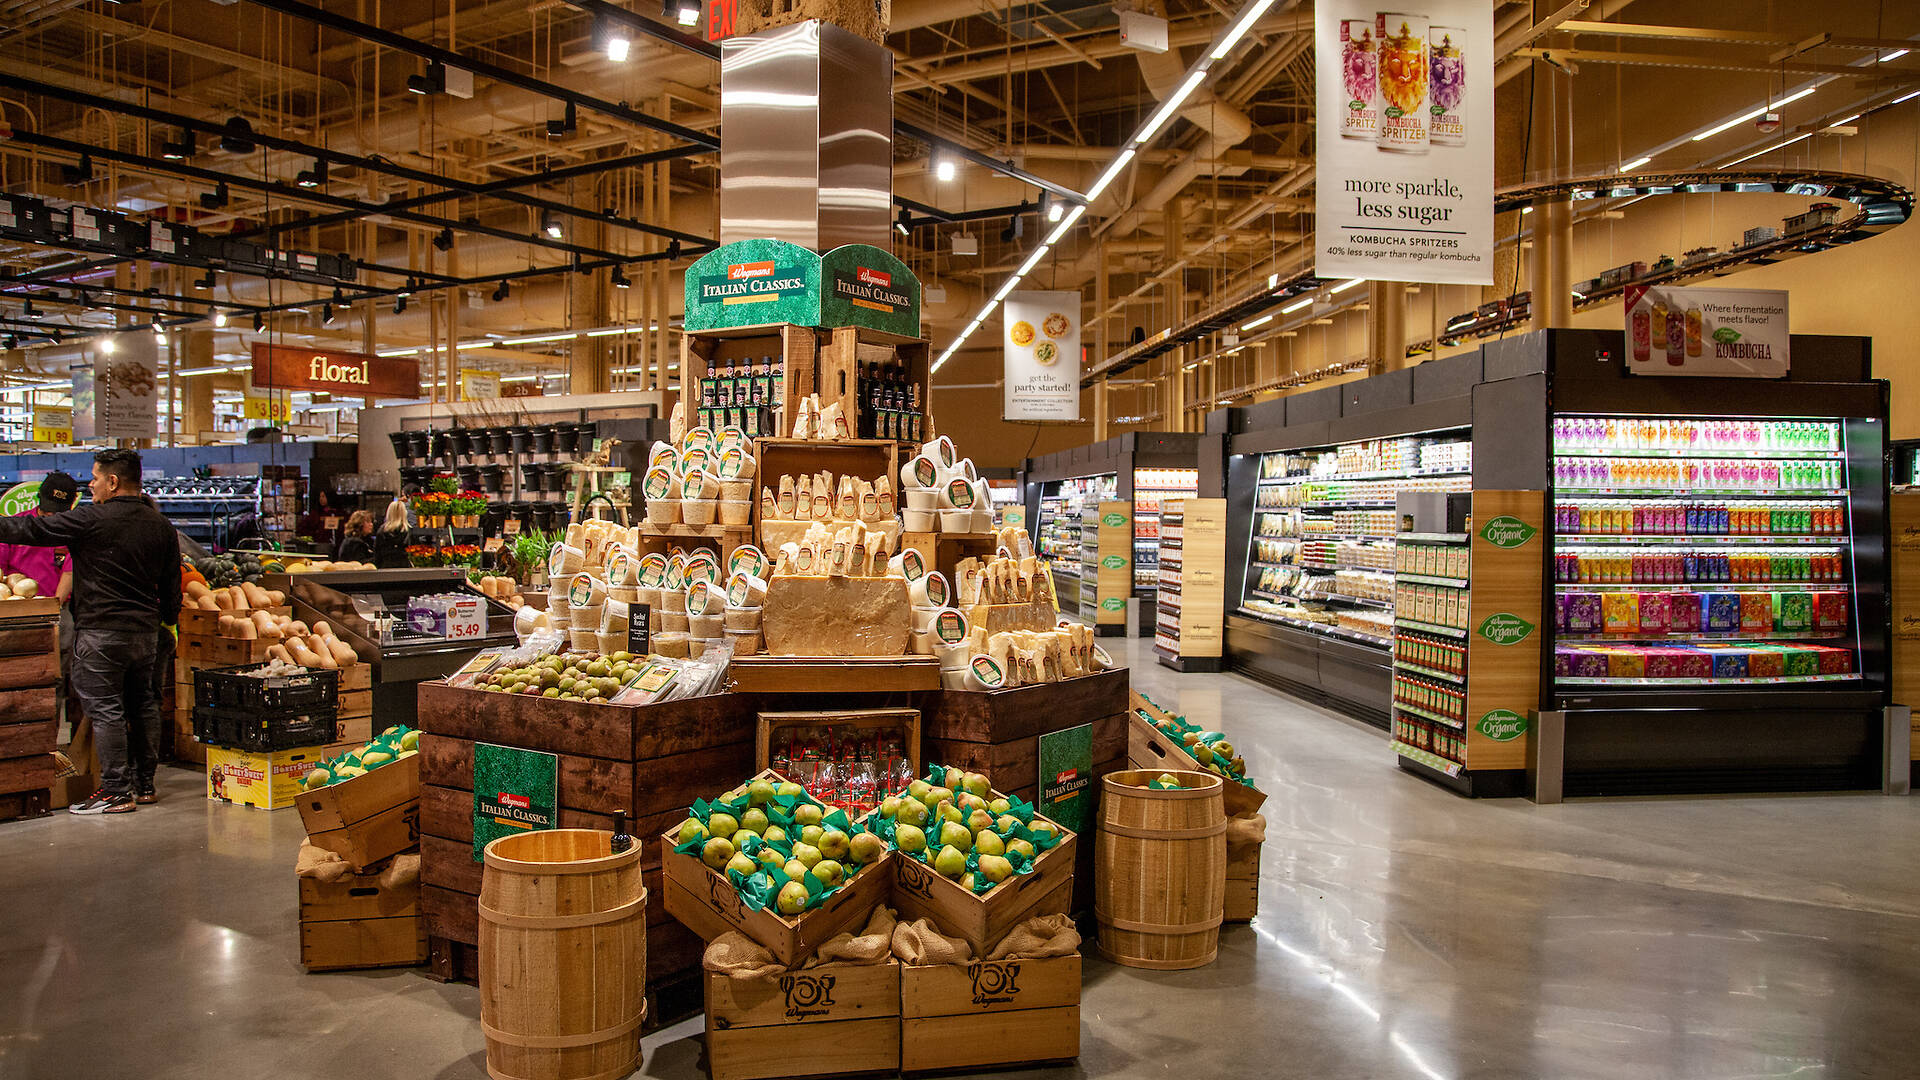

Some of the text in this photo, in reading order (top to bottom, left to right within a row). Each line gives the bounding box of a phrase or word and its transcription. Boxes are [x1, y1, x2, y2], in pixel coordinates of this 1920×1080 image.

[709, 0, 737, 41] EXI
[1346, 118, 1375, 128] SPRITZ
[1432, 123, 1463, 134] PRITZER
[1382, 127, 1426, 140] SPRITZER
[1345, 178, 1464, 200] more sparkle,
[1355, 197, 1453, 225] less sugar
[1350, 235, 1458, 247] KOMBUCHA SPRITZERS
[1327, 246, 1481, 262] 40% less sugar than regular kombucha
[733, 266, 772, 282] Wegmans
[860, 271, 890, 288] Wegmans
[703, 281, 748, 297] ITALIAN
[837, 279, 871, 299] ITALIAN
[1703, 303, 1784, 315] Where fermentation
[1718, 314, 1769, 324] meets flavor!
[1715, 343, 1772, 360] KOMBUCHA
[309, 356, 370, 385] floral
[1043, 373, 1056, 382] the
[1014, 383, 1071, 393] party started!
[1493, 519, 1522, 531] Wegmans
[1488, 528, 1526, 545] Organic
[1491, 616, 1520, 628] Wegmans
[452, 624, 480, 637] $5.49
[1486, 625, 1524, 641] Organic
[1488, 713, 1518, 724] Wegmans
[1483, 722, 1521, 738] Organic
[501, 794, 528, 808] Wegmans
[481, 802, 511, 817] ITALIAN
[786, 1006, 829, 1021] Wegmans
